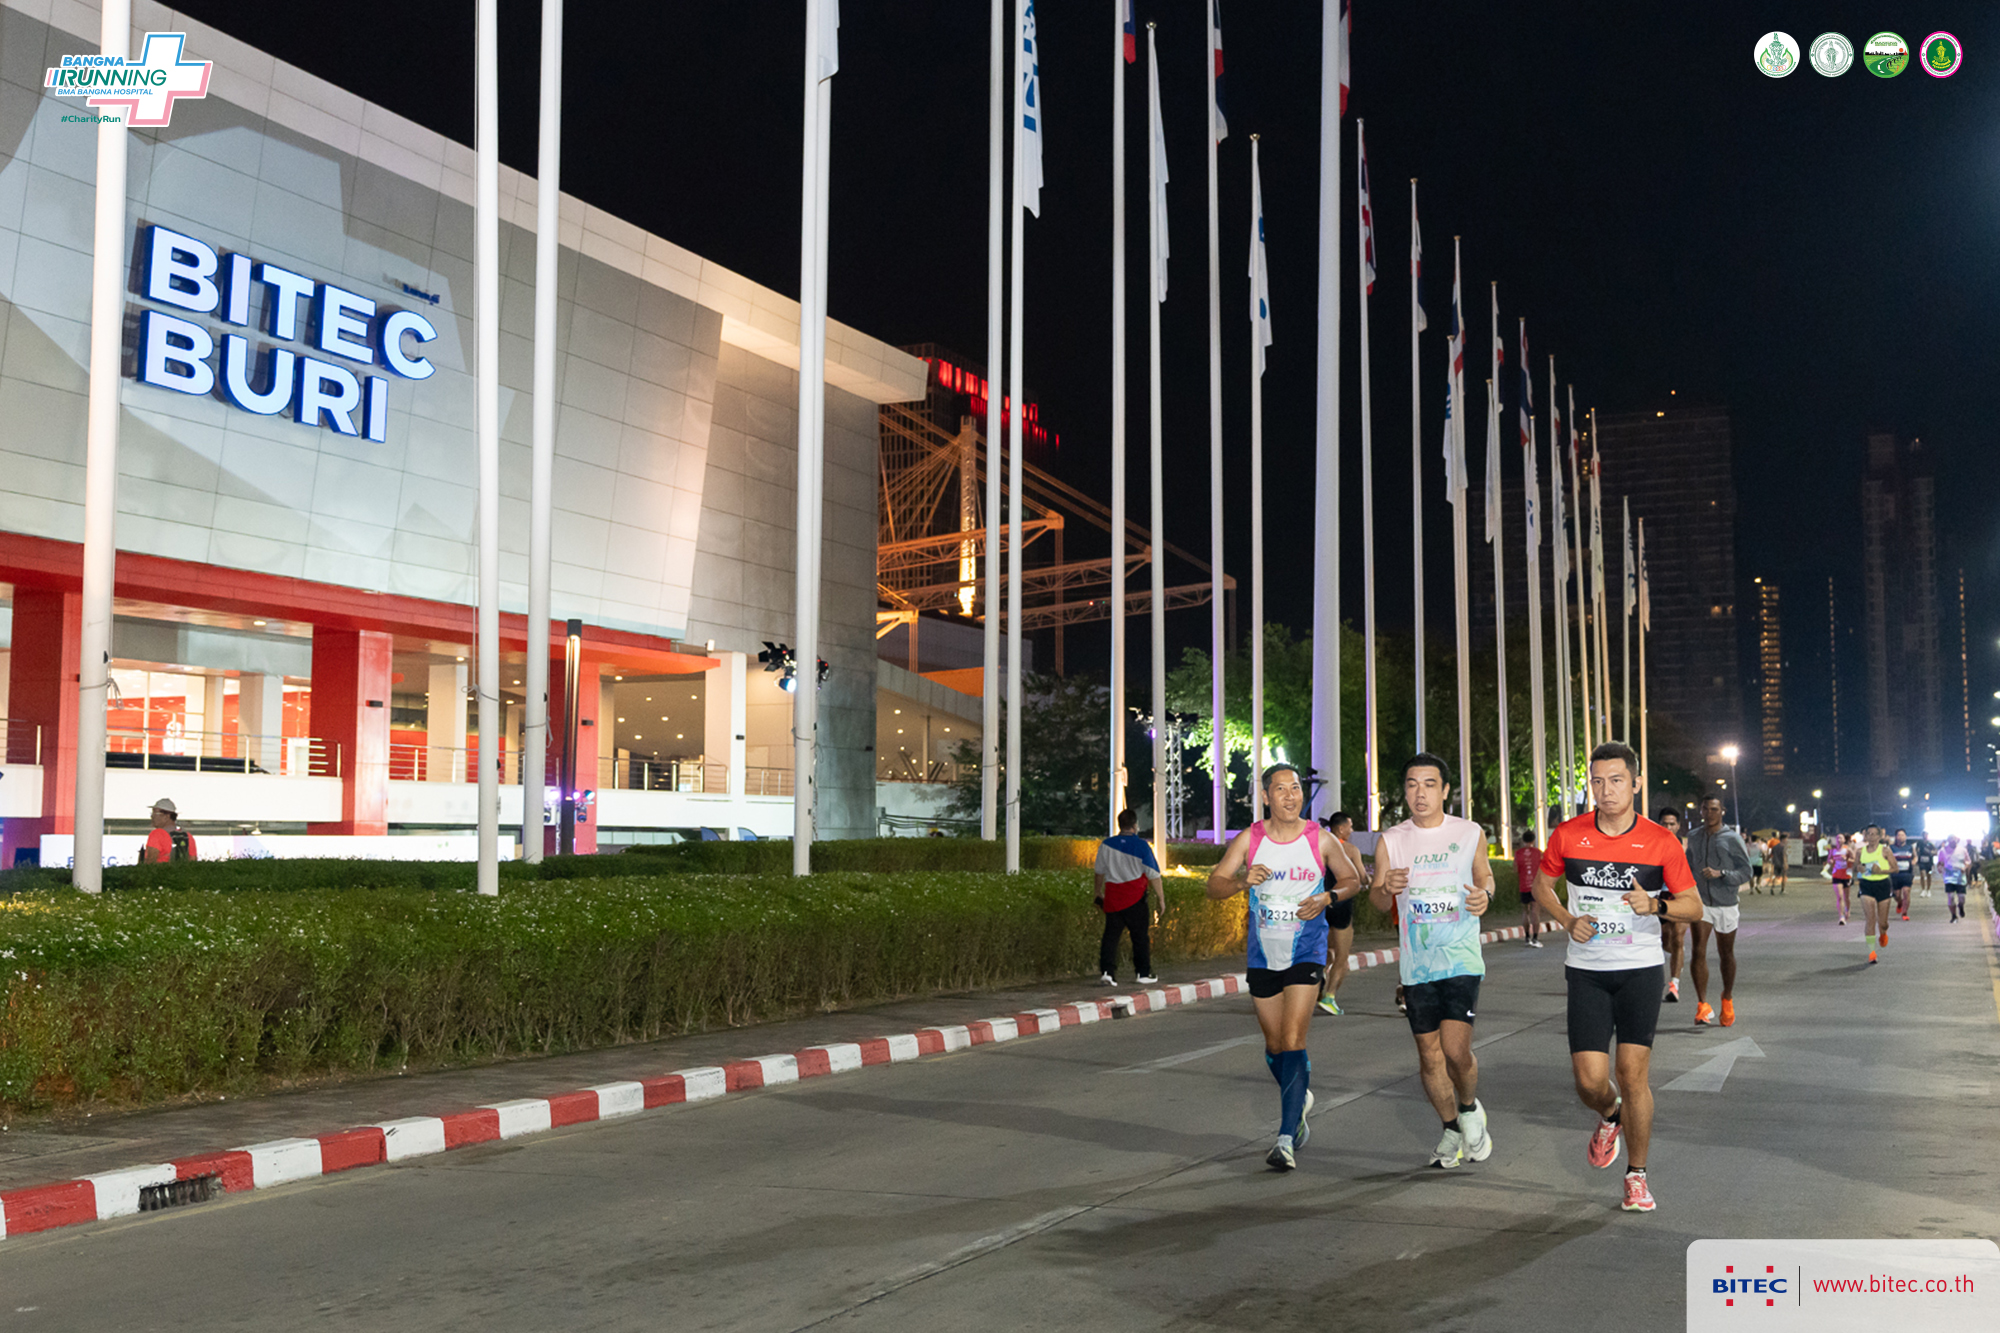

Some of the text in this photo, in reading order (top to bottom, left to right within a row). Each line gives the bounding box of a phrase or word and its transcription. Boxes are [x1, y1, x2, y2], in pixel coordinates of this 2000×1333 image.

[141, 224, 438, 380] BITEC
[137, 309, 389, 444] BURI
[1266, 866, 1316, 882] ow Life
[1582, 876, 1633, 889] WHISKY
[1413, 902, 1454, 914] M2394
[1593, 922, 1625, 934] 2393
